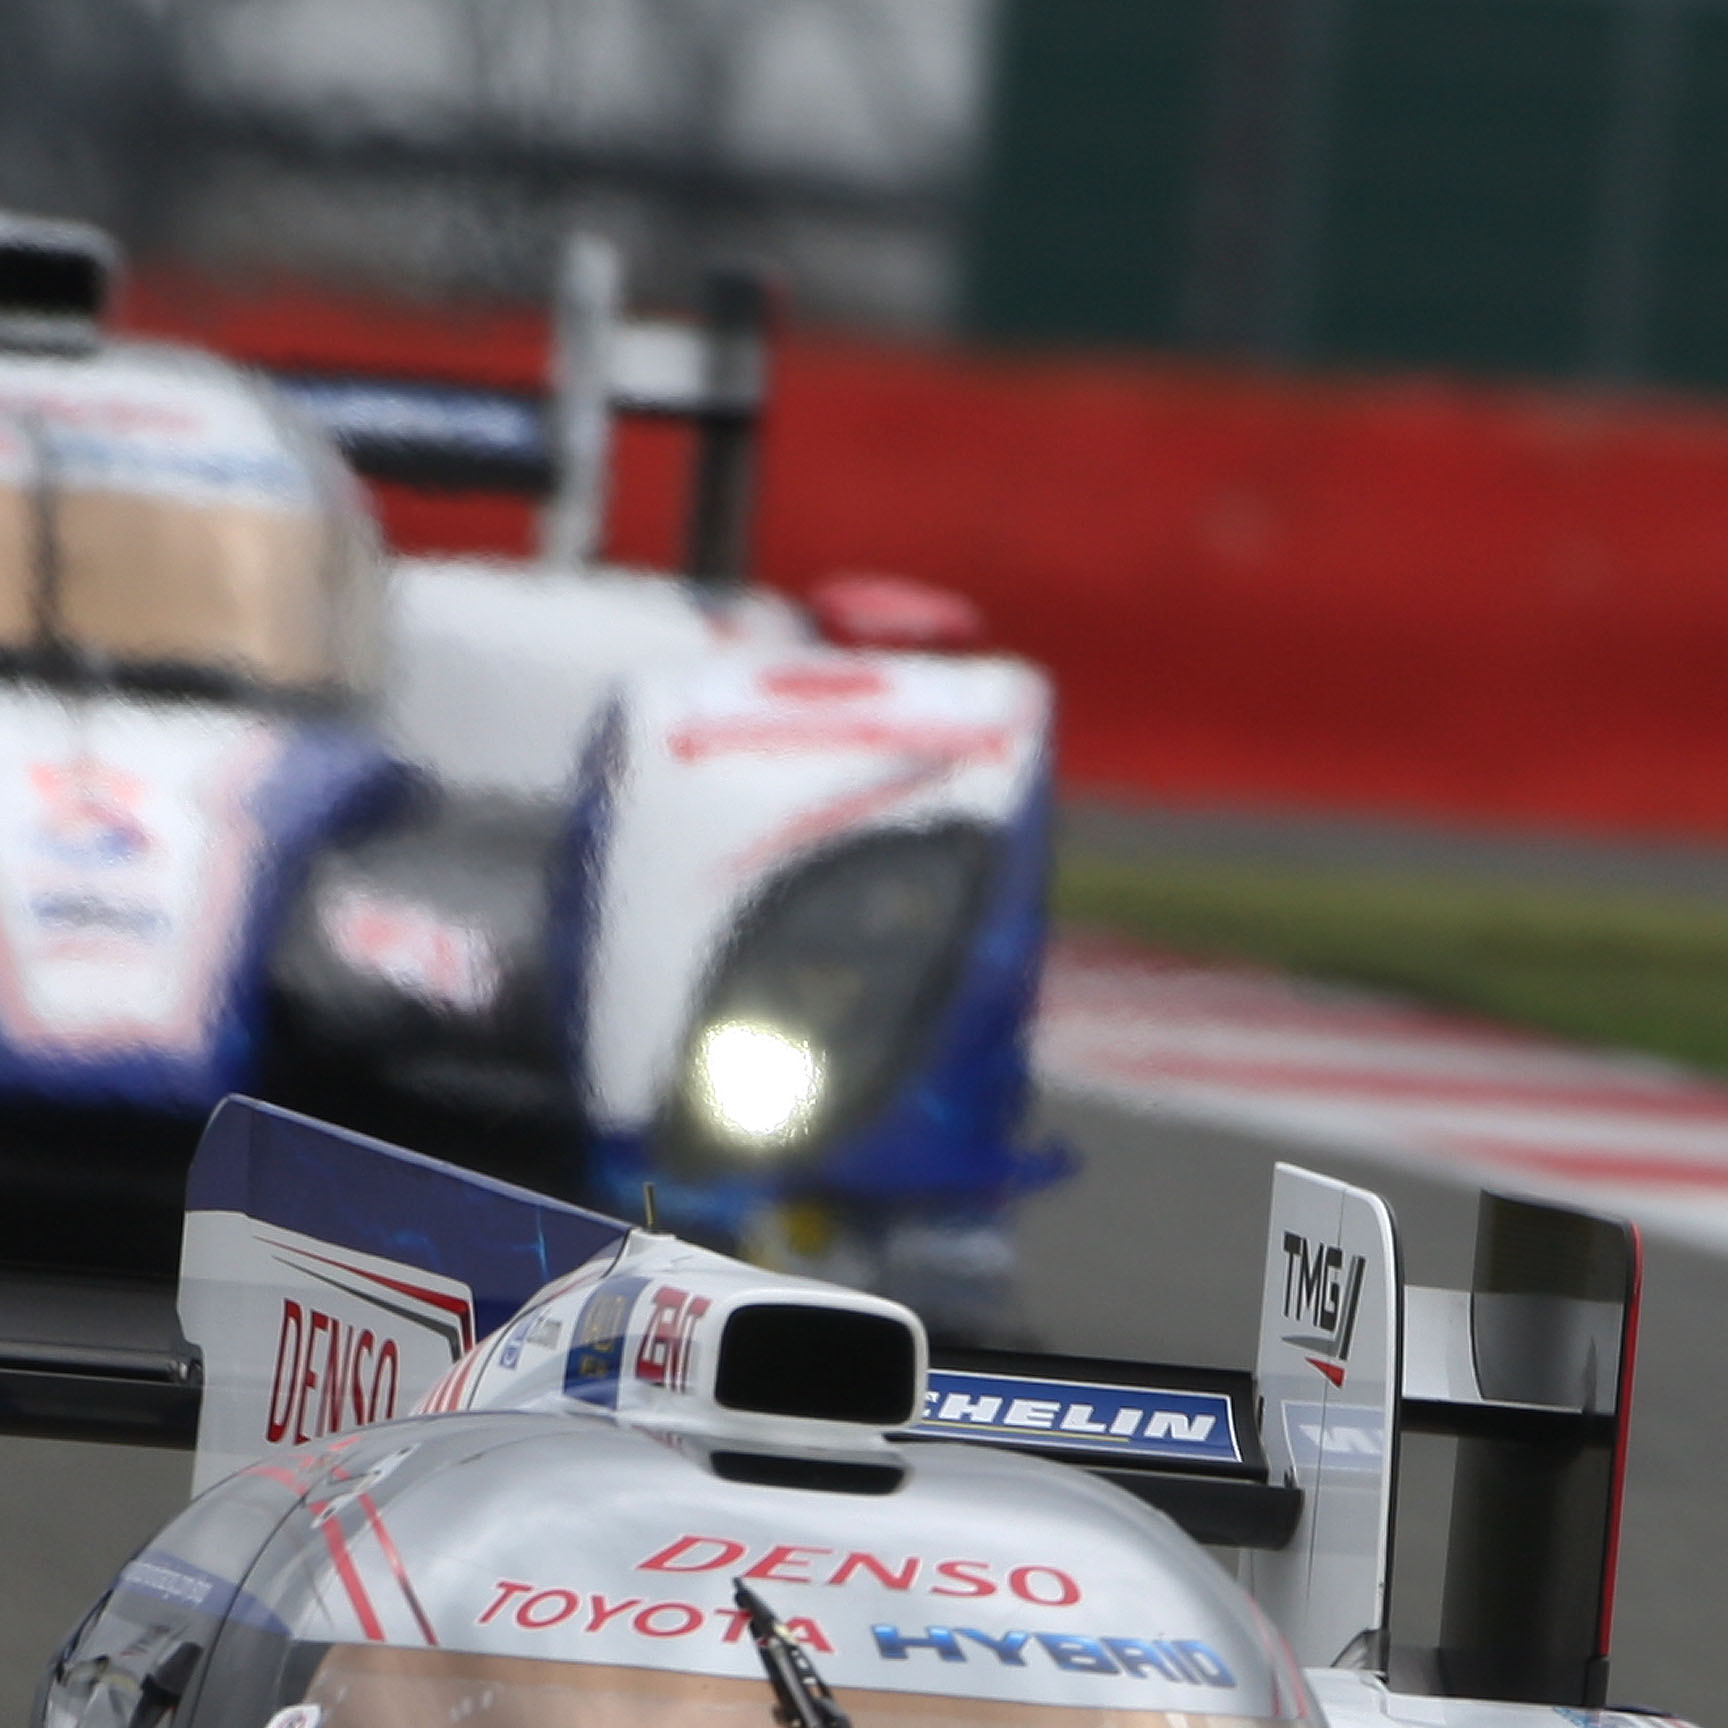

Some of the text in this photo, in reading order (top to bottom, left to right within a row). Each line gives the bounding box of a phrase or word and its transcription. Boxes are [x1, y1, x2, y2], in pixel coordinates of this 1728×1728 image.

[266, 1298, 398, 1446] DENSO
[637, 1535, 1084, 1608] DENSO
[476, 1580, 1238, 1688] TOYOTA HYBRID
